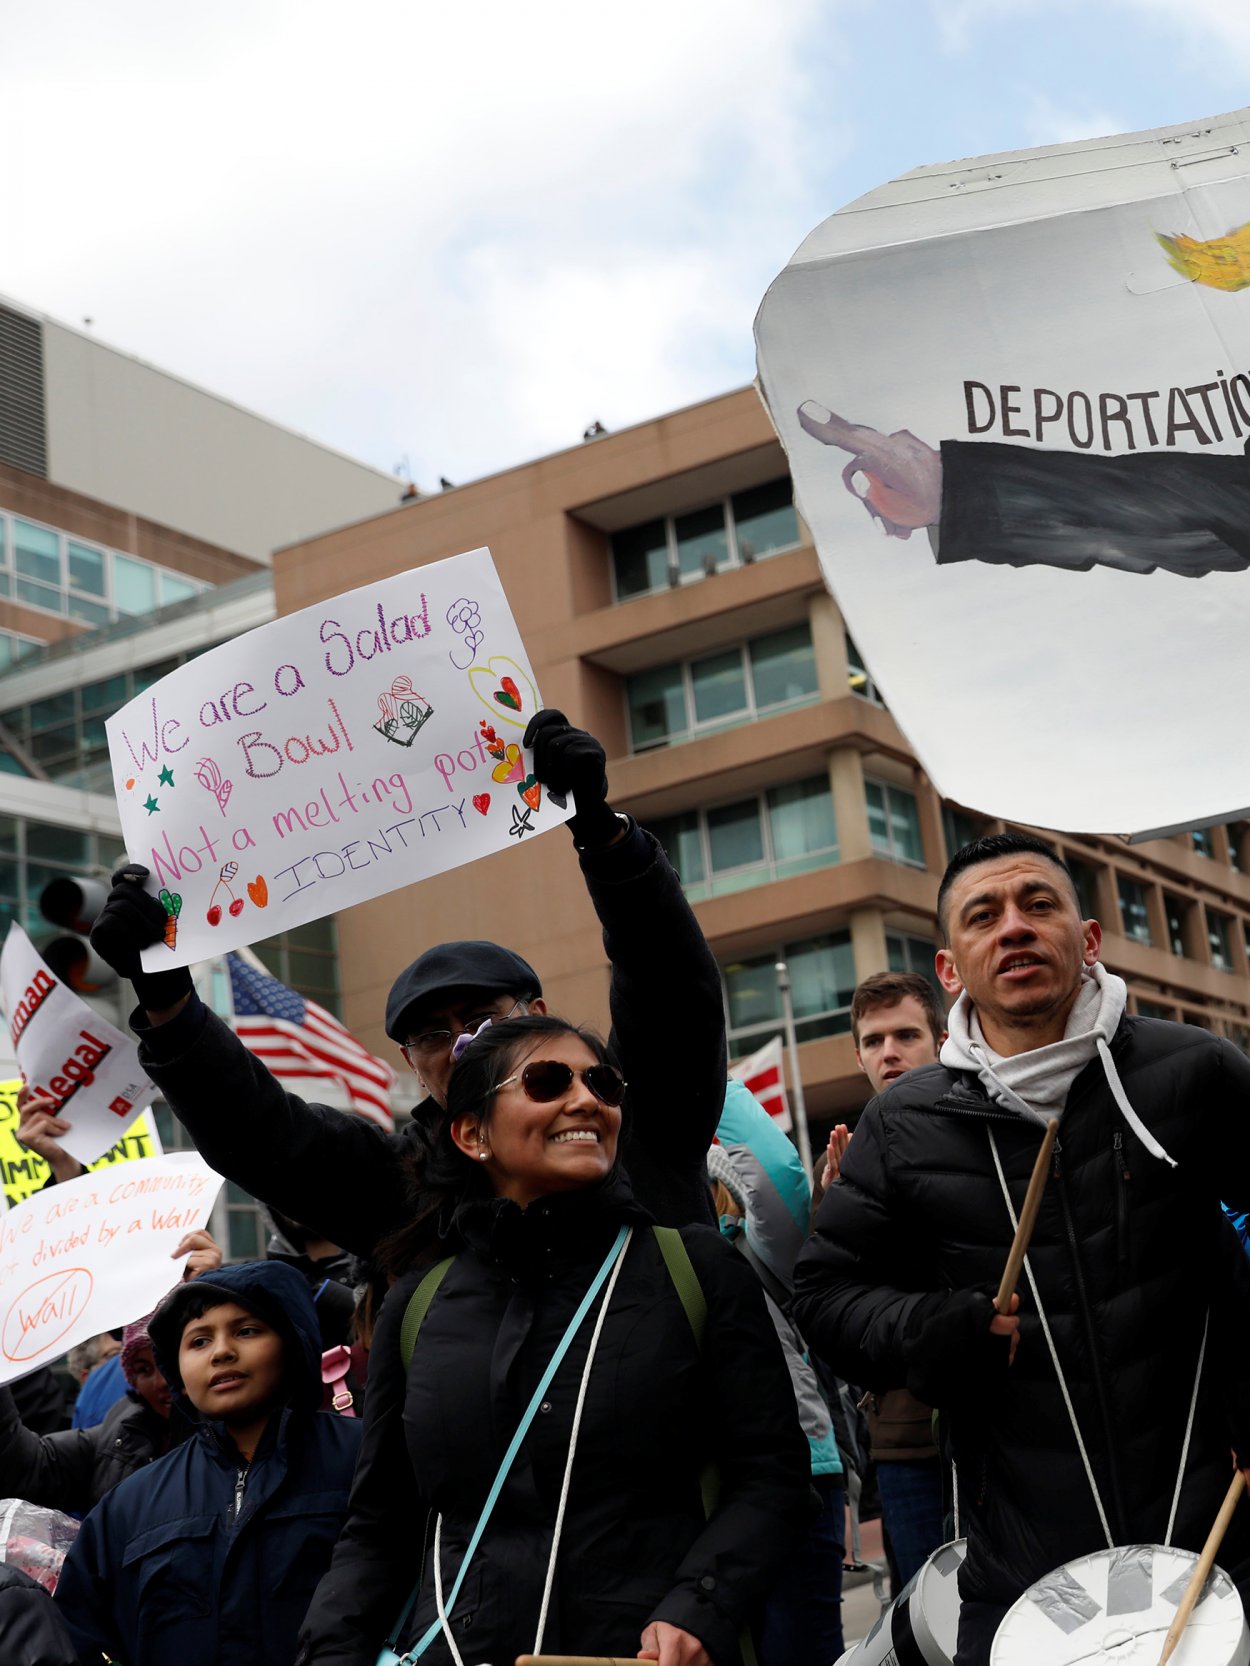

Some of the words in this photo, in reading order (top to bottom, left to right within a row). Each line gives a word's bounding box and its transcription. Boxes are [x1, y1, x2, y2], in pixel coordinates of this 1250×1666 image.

[122, 698, 190, 771] We
[199, 682, 267, 728] are
[274, 664, 306, 696] a
[319, 592, 432, 677] Salad
[237, 698, 355, 779] Bowl
[151, 825, 221, 887] Not
[231, 827, 257, 850] a
[272, 772, 414, 839] melting
[434, 730, 489, 793] pot
[273, 798, 468, 903] IDENTITY
[32, 1225, 91, 1267] divided
[97, 1219, 121, 1248] by
[128, 1219, 142, 1234] a
